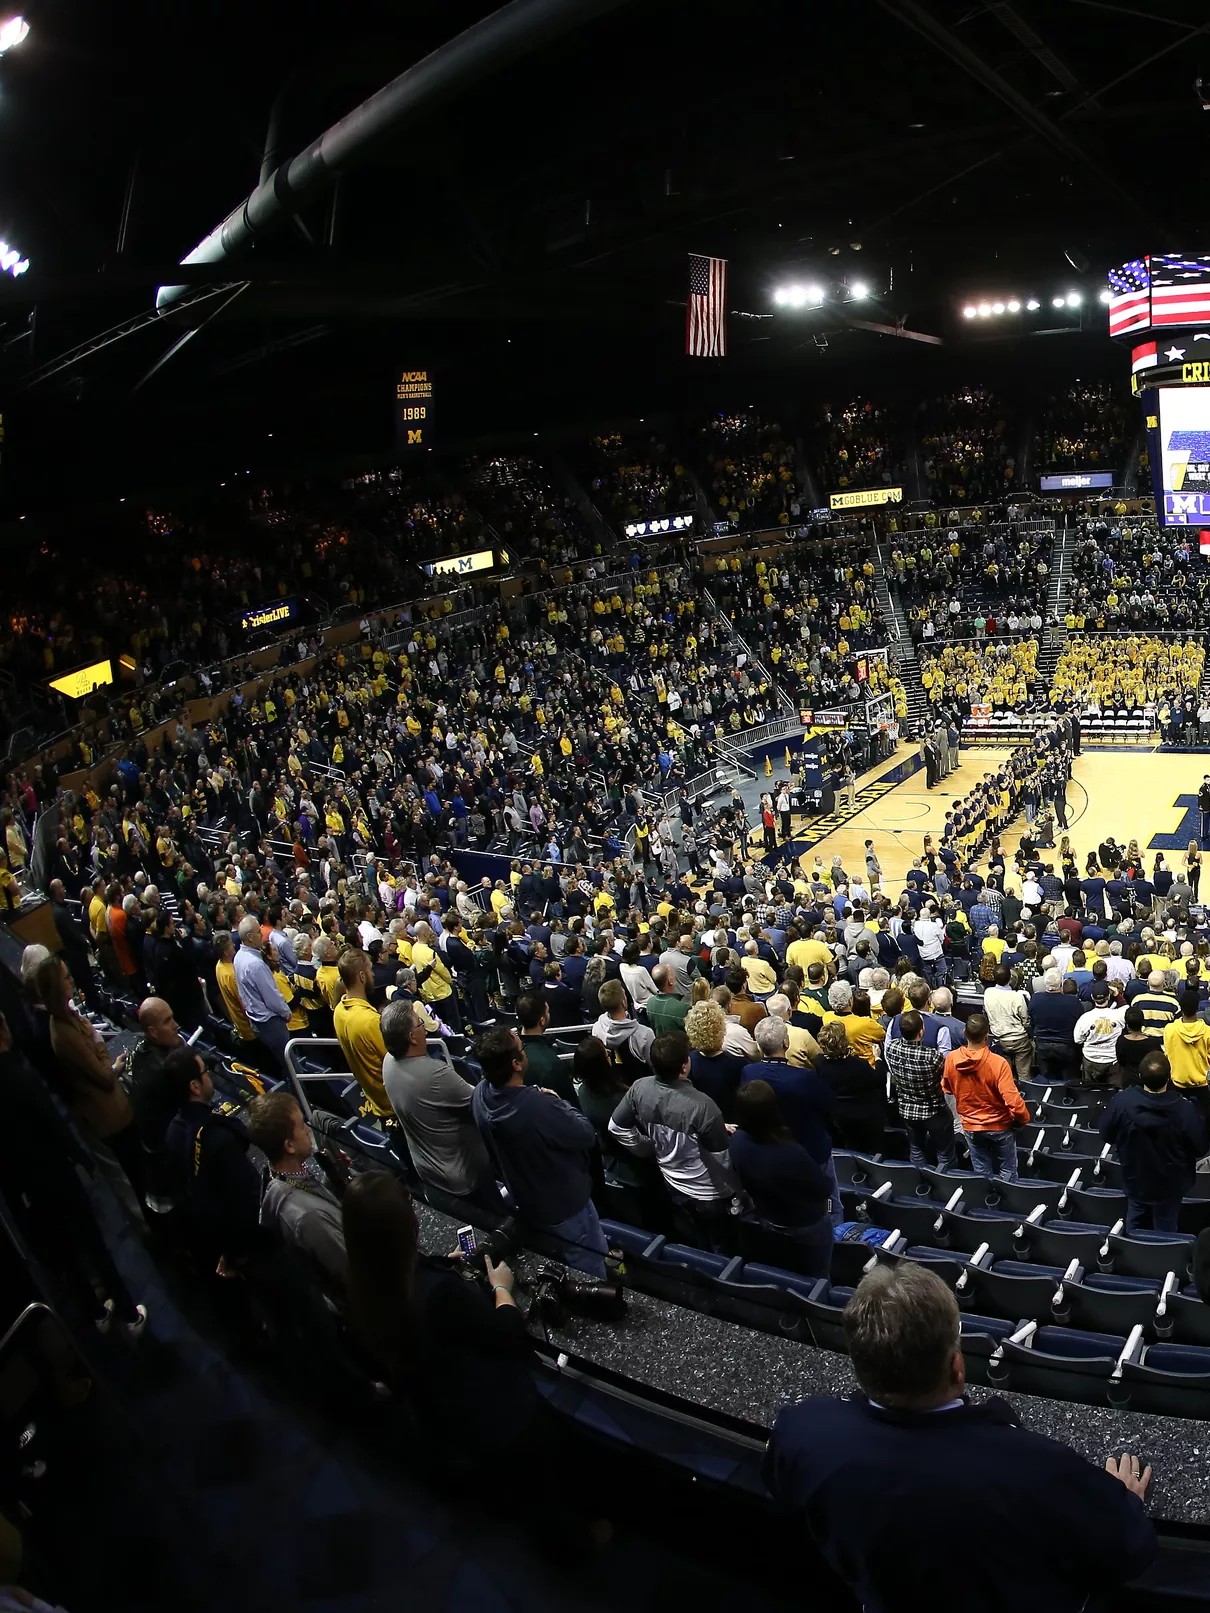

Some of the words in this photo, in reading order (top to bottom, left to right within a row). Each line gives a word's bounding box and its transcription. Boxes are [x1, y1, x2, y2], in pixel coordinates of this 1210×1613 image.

[402, 372, 427, 382] NCAA
[397, 383, 432, 393] CHAMPIONS
[403, 407, 426, 420] 1989
[407, 430, 422, 444] M
[1061, 476, 1091, 487] meijer
[1172, 496, 1198, 513] M
[458, 557, 473, 572] M
